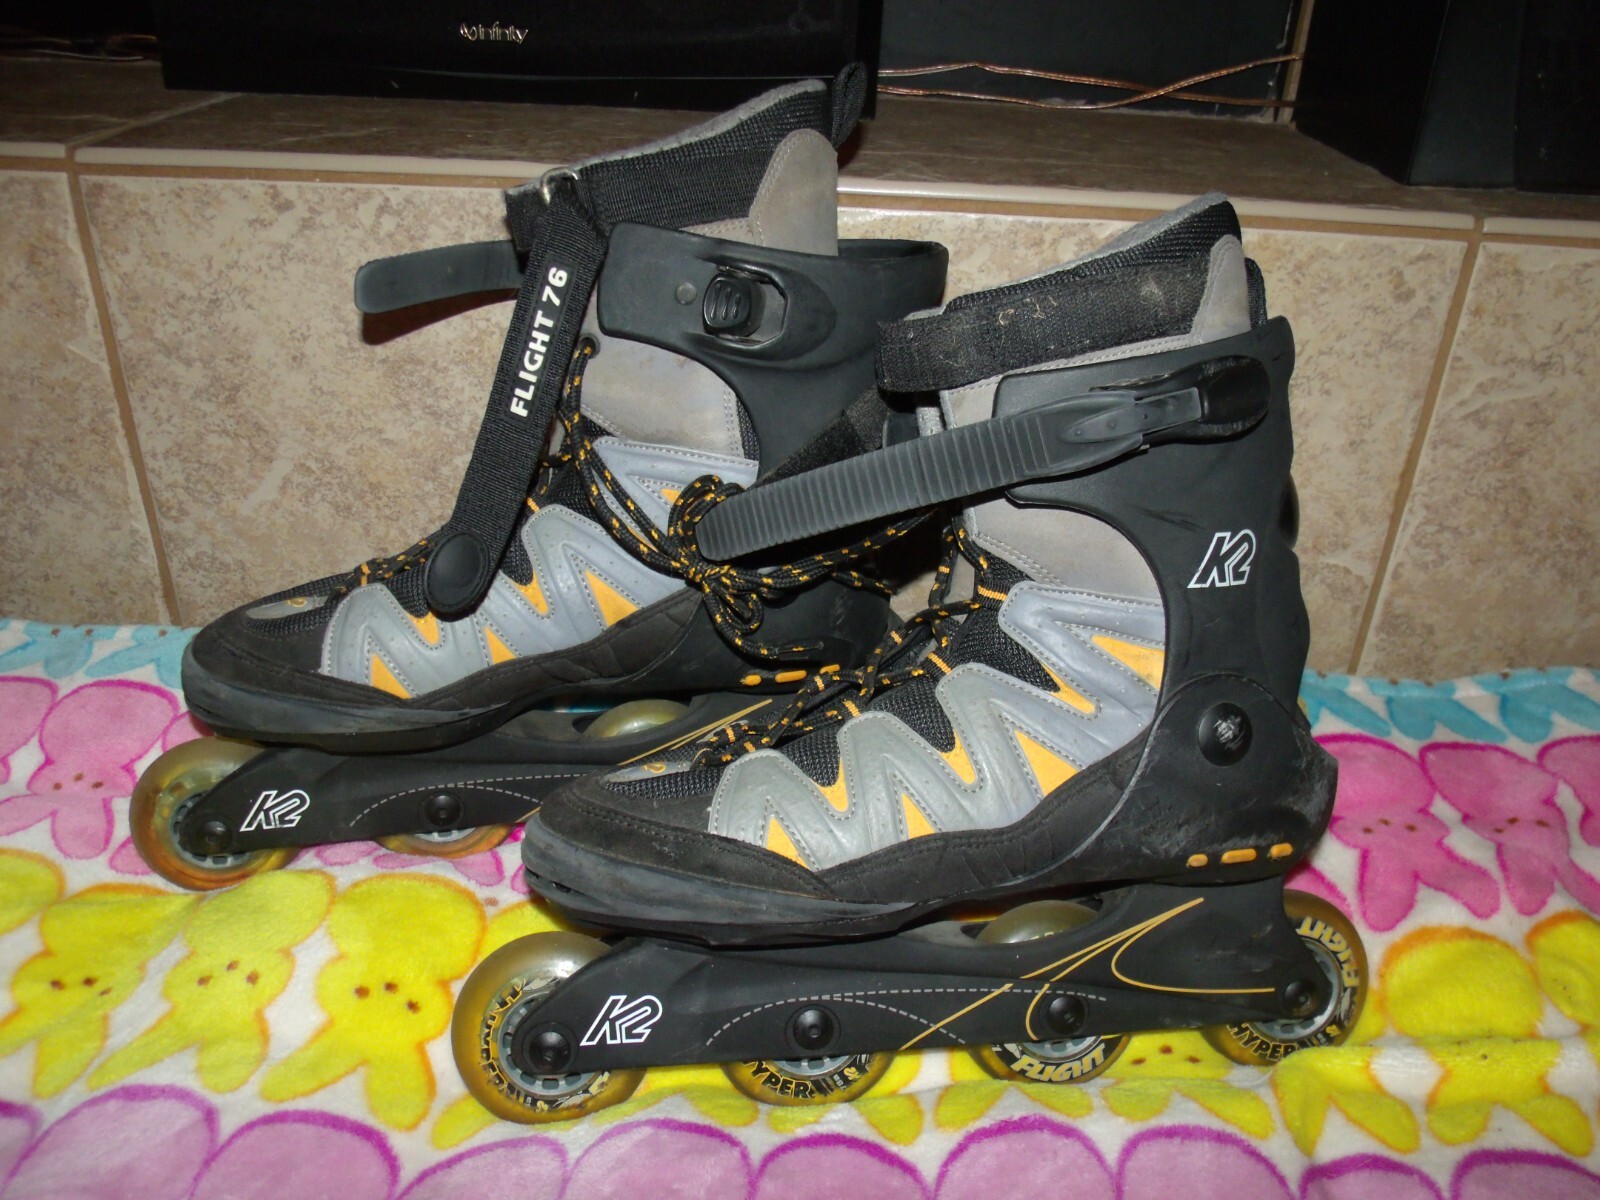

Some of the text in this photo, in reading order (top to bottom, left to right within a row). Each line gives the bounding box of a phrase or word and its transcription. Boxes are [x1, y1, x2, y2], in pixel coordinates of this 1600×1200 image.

[510, 267, 568, 417] FLIGHT 76
[1187, 529, 1256, 589] K2
[239, 789, 310, 832] K2
[580, 995, 663, 1046] K2
[743, 1060, 812, 1099] YPER
[1010, 1043, 1105, 1082] FLIGHT
